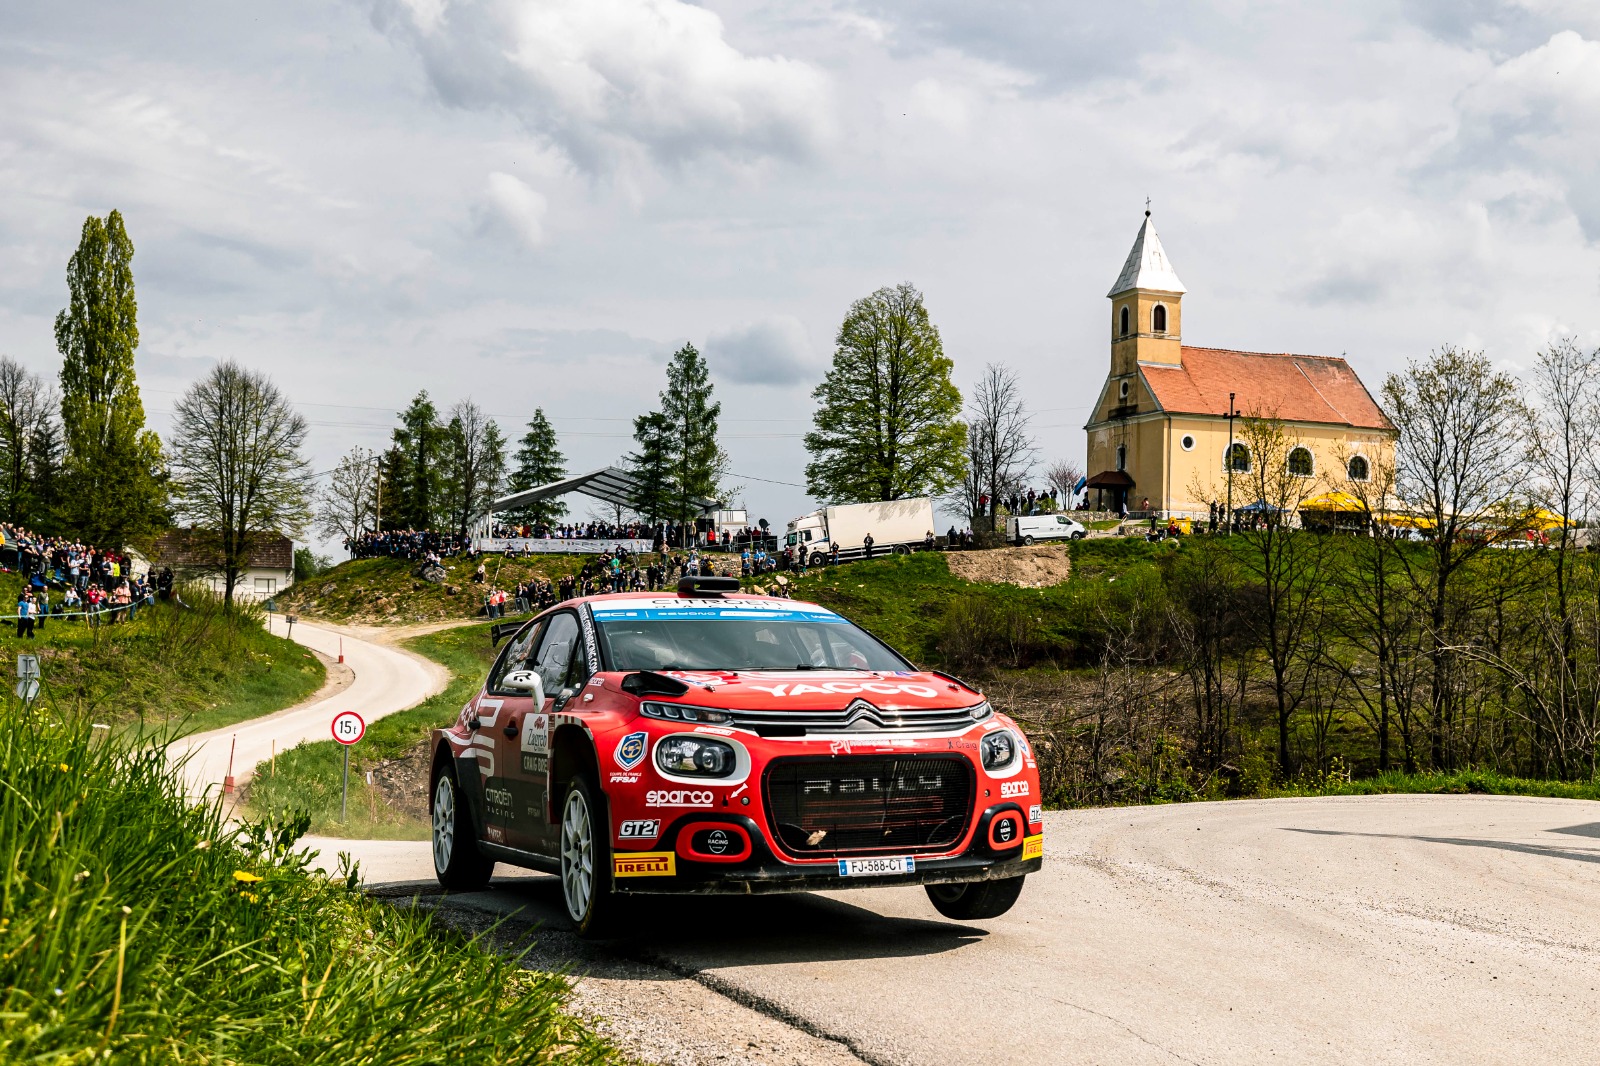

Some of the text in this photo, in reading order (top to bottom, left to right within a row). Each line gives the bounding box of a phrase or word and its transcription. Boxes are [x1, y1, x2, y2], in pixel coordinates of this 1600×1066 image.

[748, 682, 938, 697] YACCO
[527, 728, 547, 750] Zagreb
[956, 741, 977, 750] Craig
[1001, 781, 1029, 797] sparco
[646, 790, 714, 808] sparco
[620, 820, 660, 836] GT2i
[851, 860, 902, 873] FJ-588-CT
